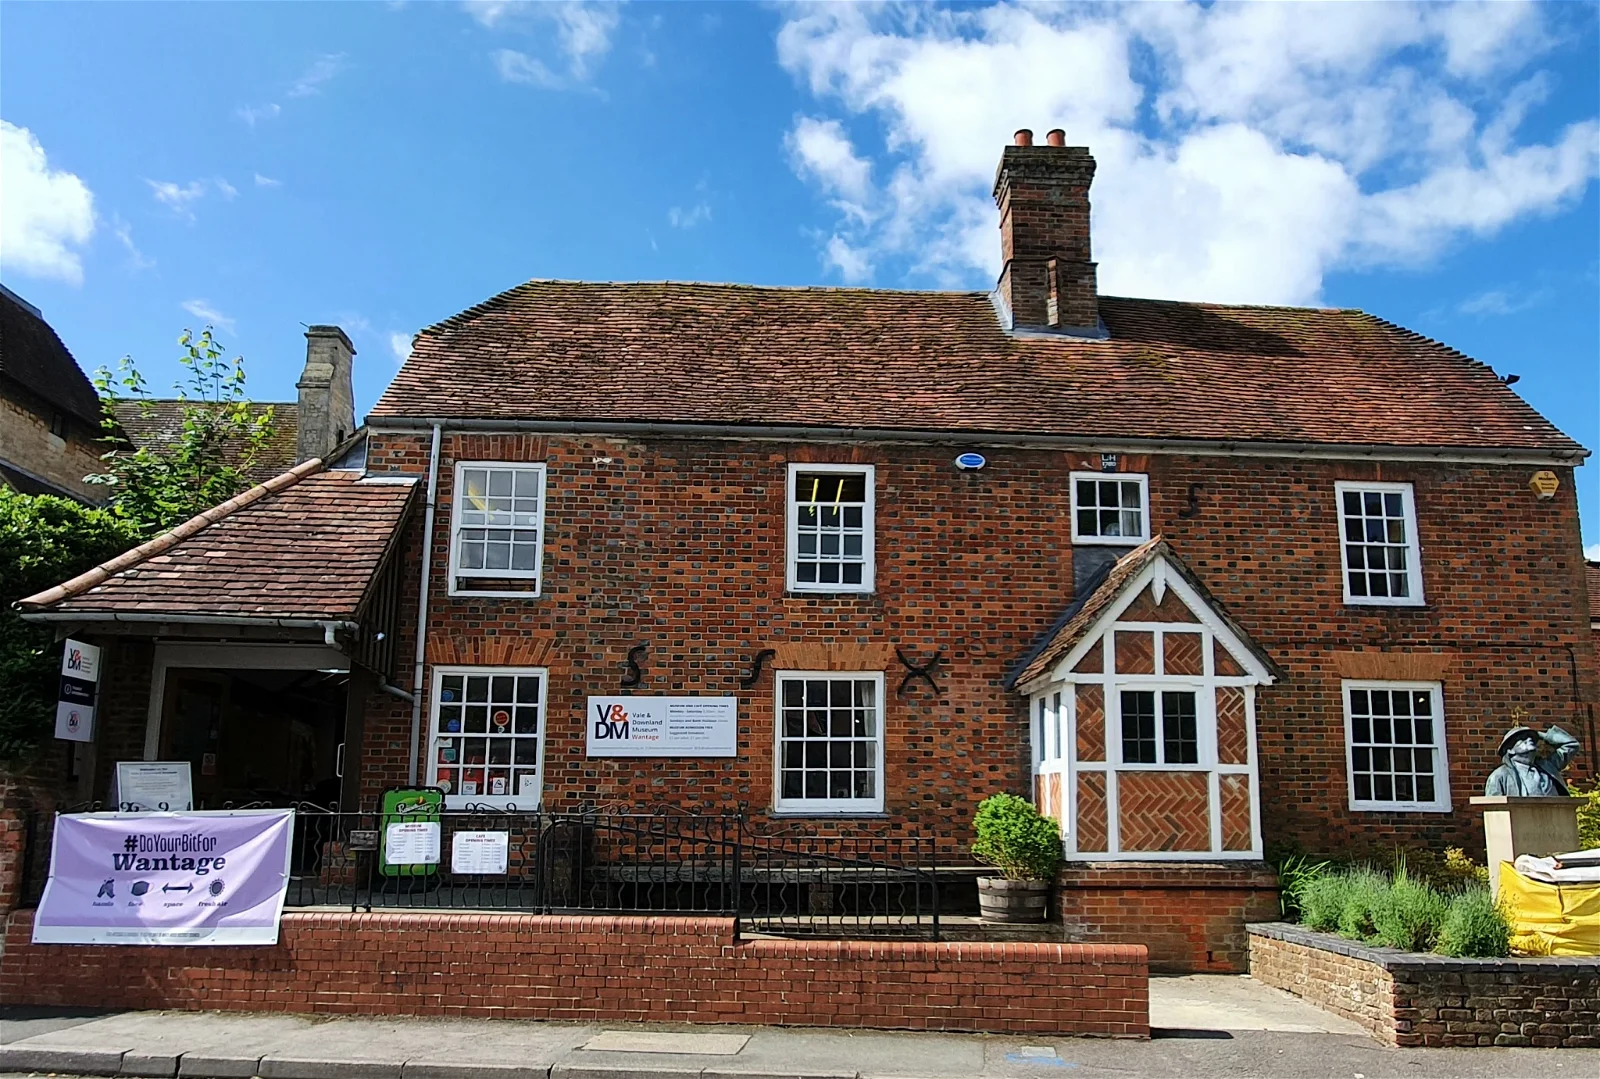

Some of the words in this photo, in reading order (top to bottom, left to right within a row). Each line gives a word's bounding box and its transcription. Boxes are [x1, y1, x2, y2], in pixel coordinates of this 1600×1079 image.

[596, 704, 628, 722] V&
[595, 722, 629, 739] DM
[124, 833, 216, 852] #DoYourBitFor
[112, 854, 226, 875] Wantage
